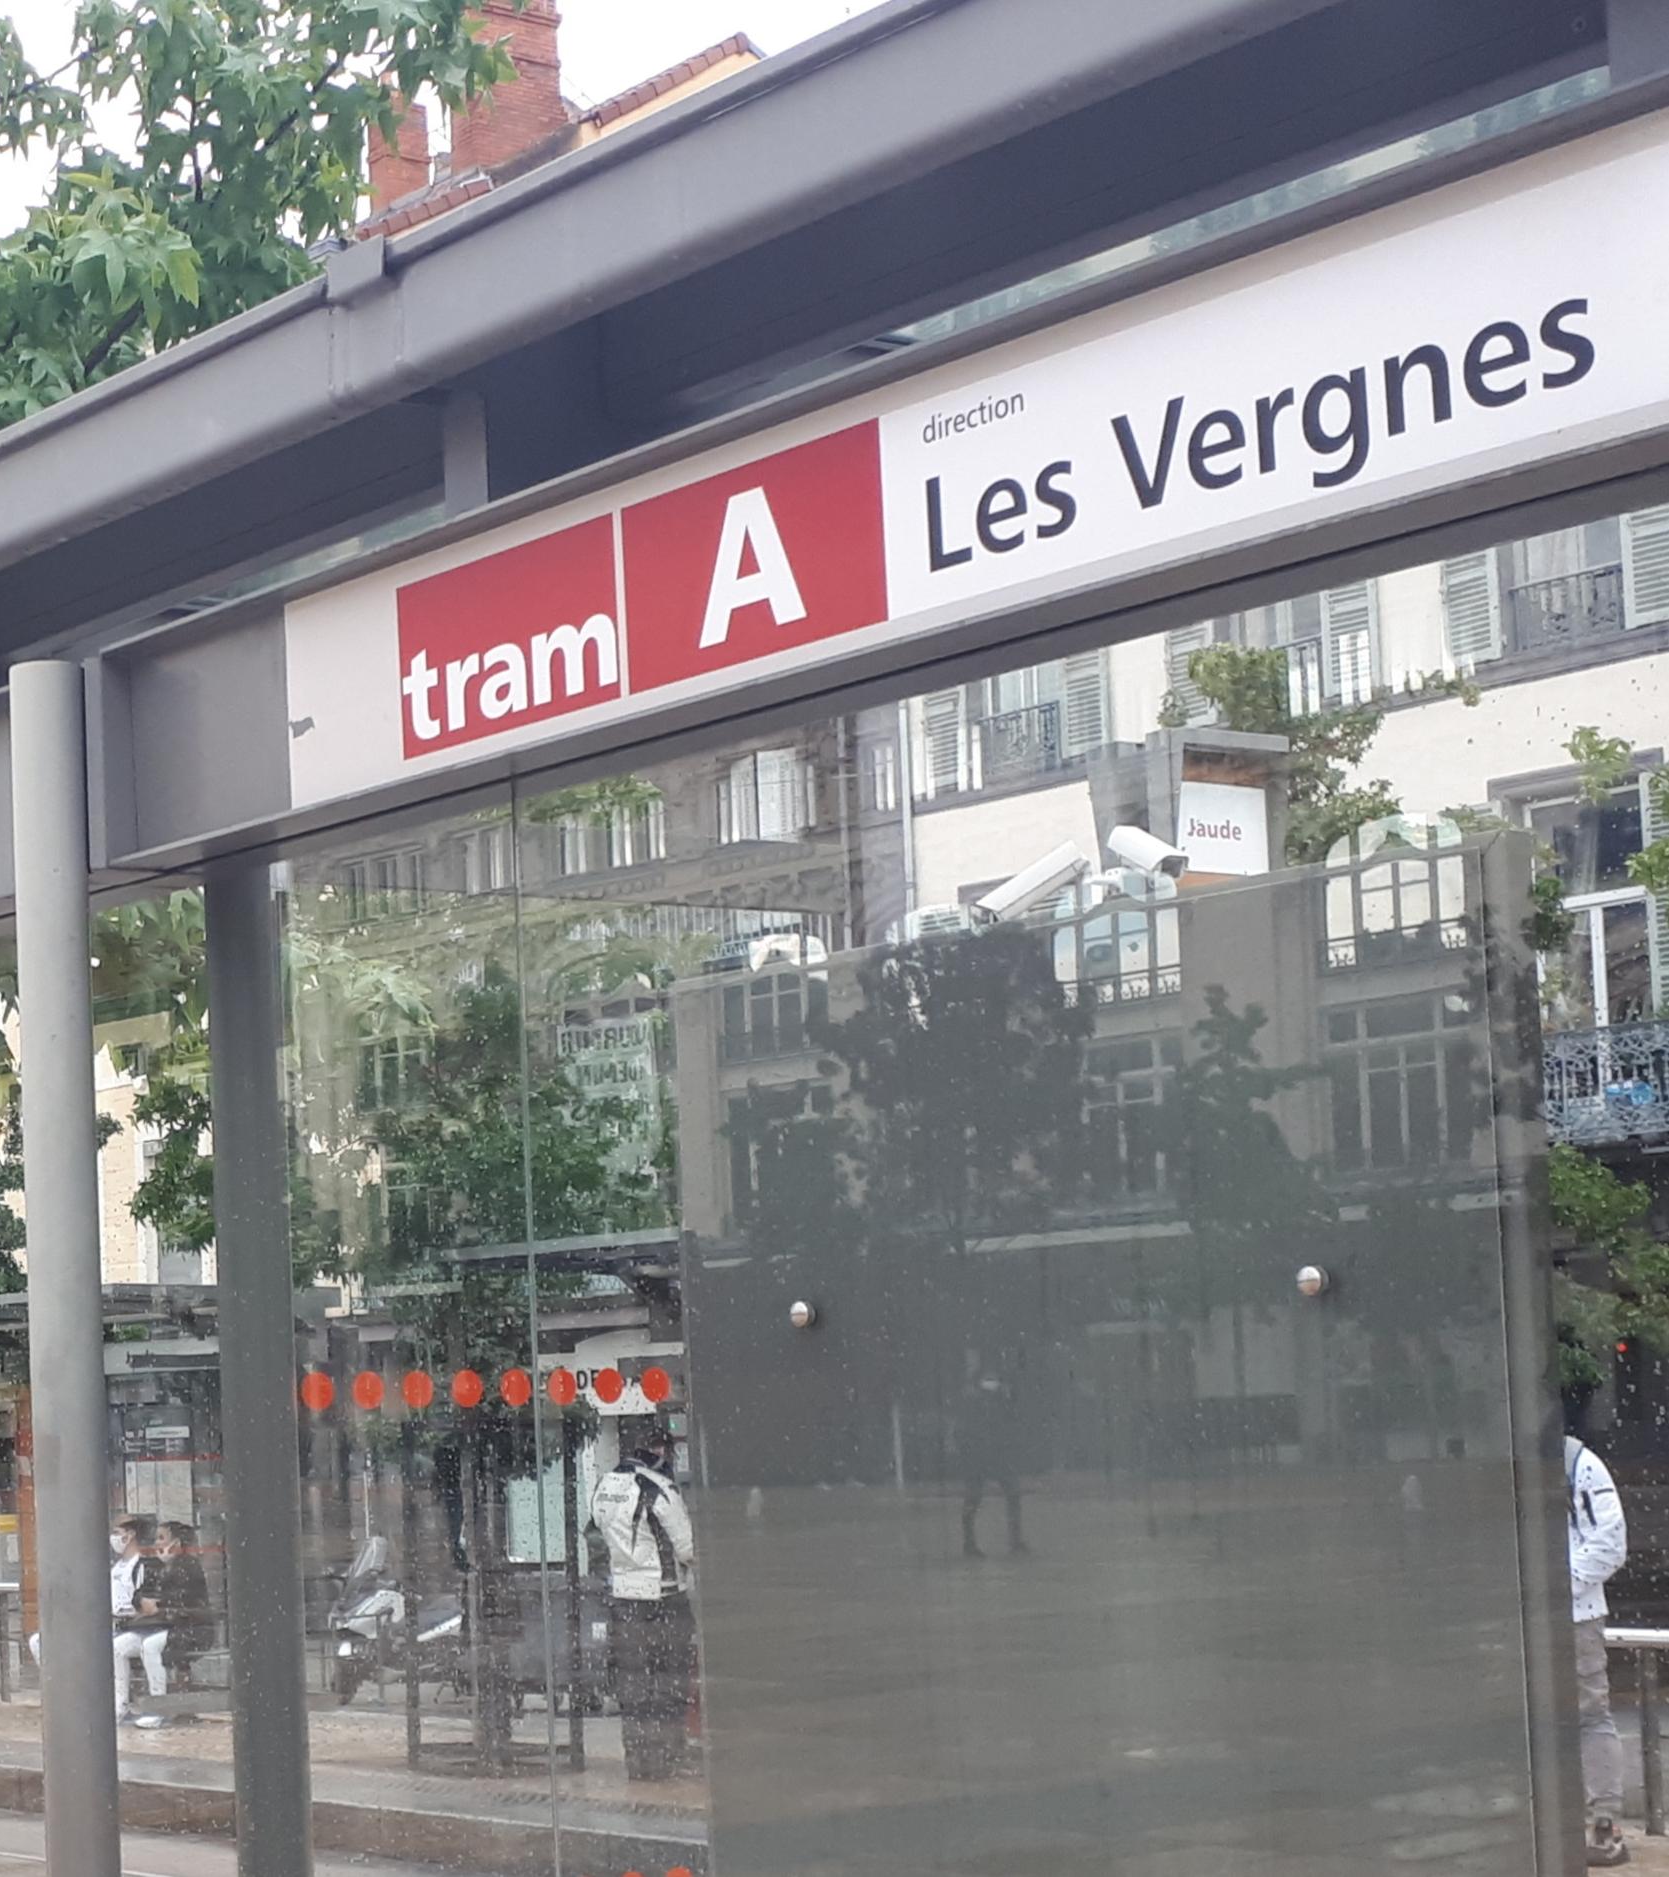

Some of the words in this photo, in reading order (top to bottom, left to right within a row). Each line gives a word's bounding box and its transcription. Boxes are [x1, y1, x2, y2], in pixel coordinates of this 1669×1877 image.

[922, 391, 1025, 445] direction
[925, 460, 1077, 574] Les
[1110, 298, 1597, 510] Vergnes
[401, 612, 619, 741] tram
[698, 485, 808, 649] A
[1187, 817, 1242, 842] Jaude
